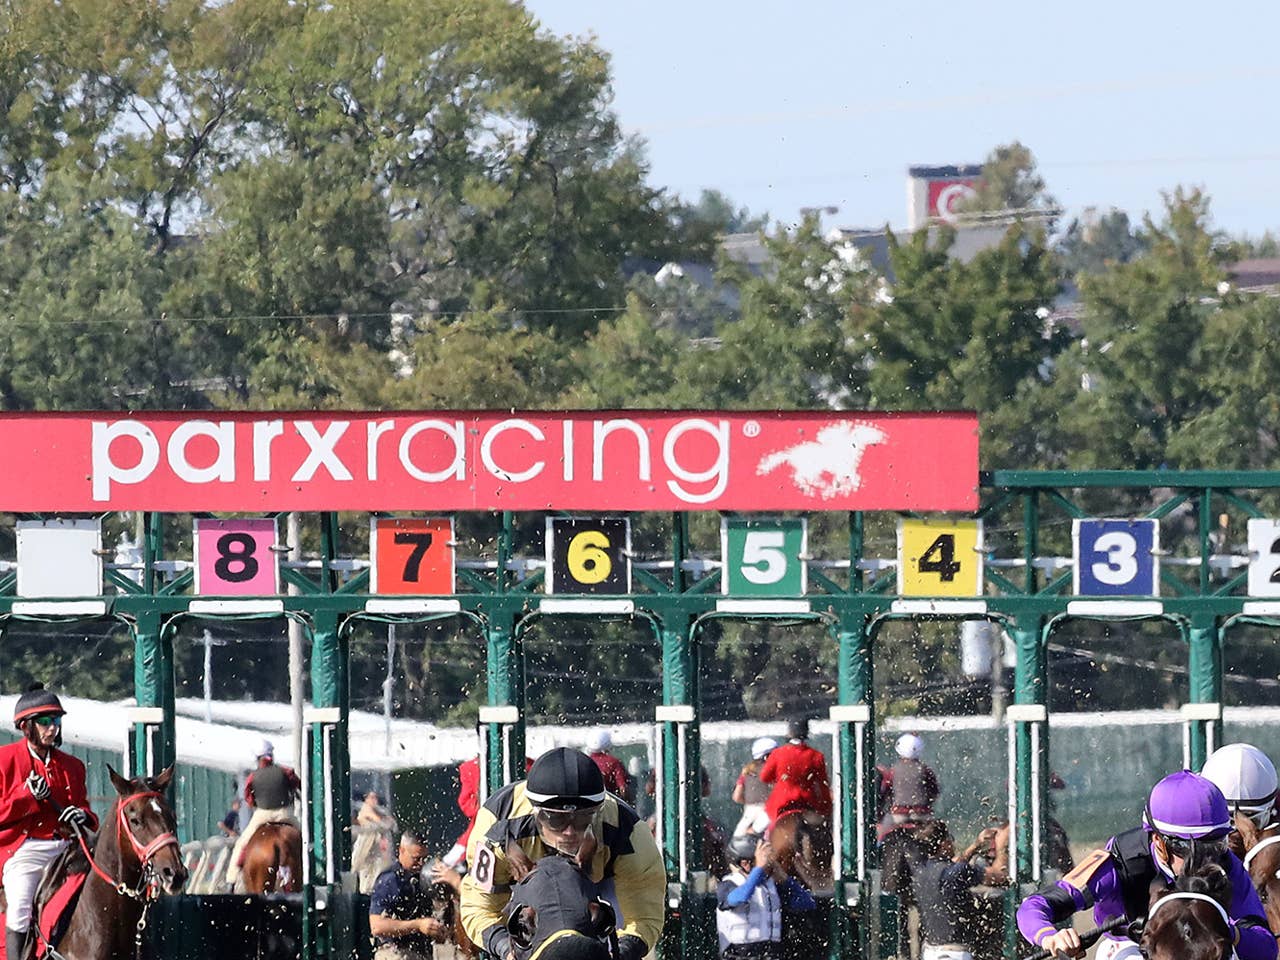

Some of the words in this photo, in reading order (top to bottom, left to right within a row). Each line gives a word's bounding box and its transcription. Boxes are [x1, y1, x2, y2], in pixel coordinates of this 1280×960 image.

[215, 533, 259, 583] 8
[395, 533, 433, 582] 7
[567, 531, 612, 584] 6
[740, 532, 787, 584] 5
[918, 535, 961, 582] 4
[1091, 532, 1138, 585] 3
[476, 849, 490, 883] 8
